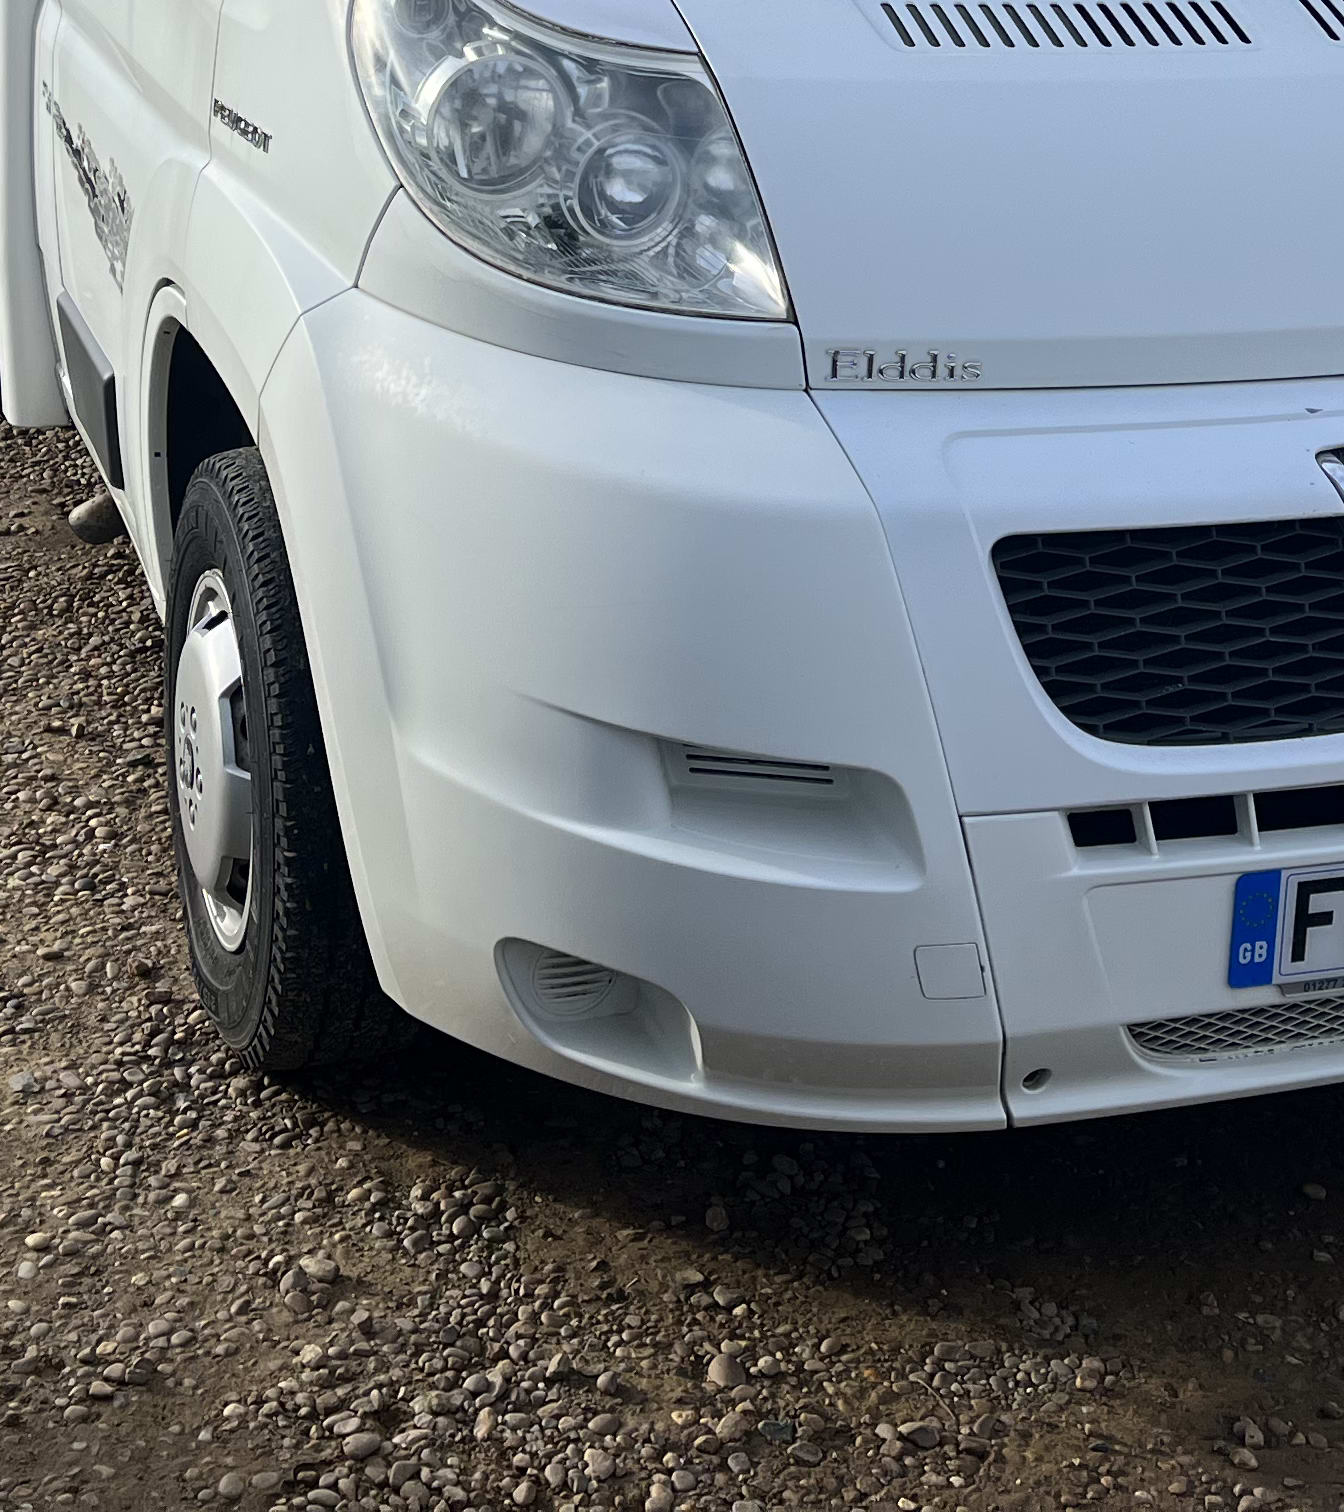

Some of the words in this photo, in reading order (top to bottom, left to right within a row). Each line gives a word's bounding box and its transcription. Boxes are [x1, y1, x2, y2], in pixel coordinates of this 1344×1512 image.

[213, 97, 273, 154] PEUGEOT
[825, 348, 982, 383] Elddis
[1238, 941, 1269, 965] GB
[1303, 978, 1338, 993] 01277
